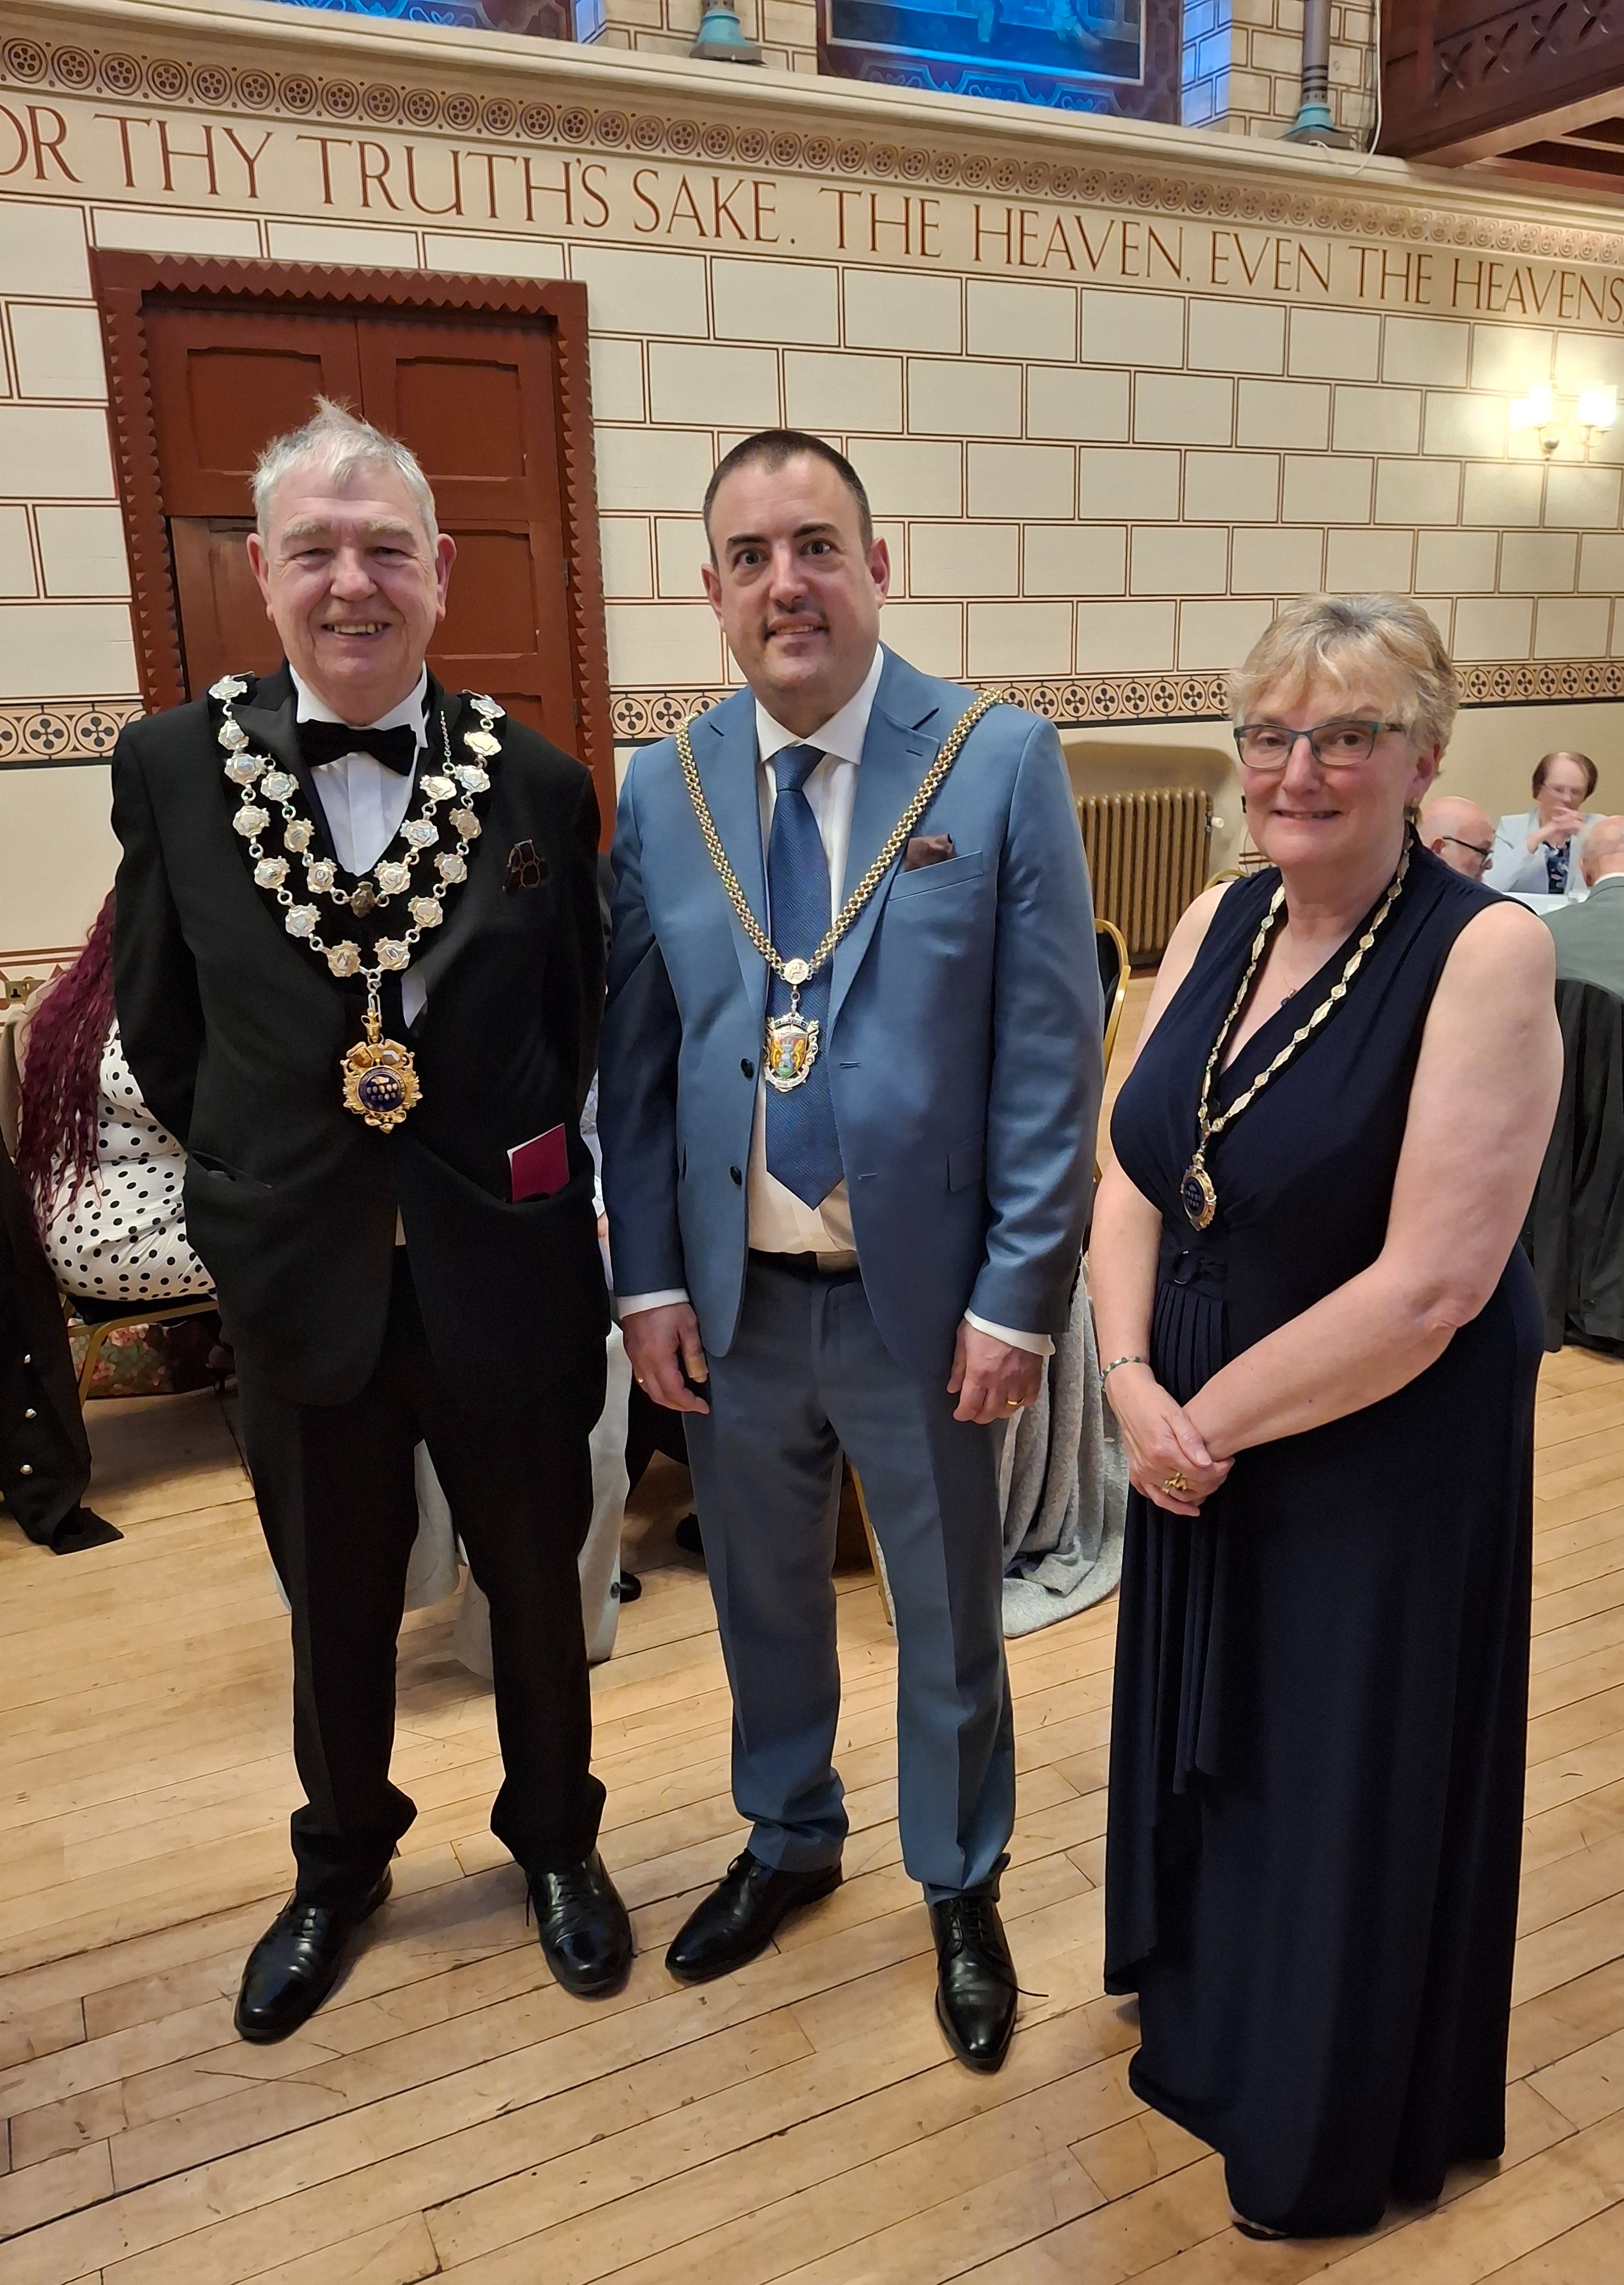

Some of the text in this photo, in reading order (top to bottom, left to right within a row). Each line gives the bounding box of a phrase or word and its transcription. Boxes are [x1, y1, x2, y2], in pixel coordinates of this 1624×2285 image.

[93, 113, 273, 198] THY
[296, 135, 609, 228] TRUTH'S
[633, 169, 796, 245] SAKE.
[818, 188, 942, 258] THE
[973, 204, 1191, 282] HEAVEN.
[1210, 230, 1332, 293] EVEN
[1348, 246, 1433, 305] THE
